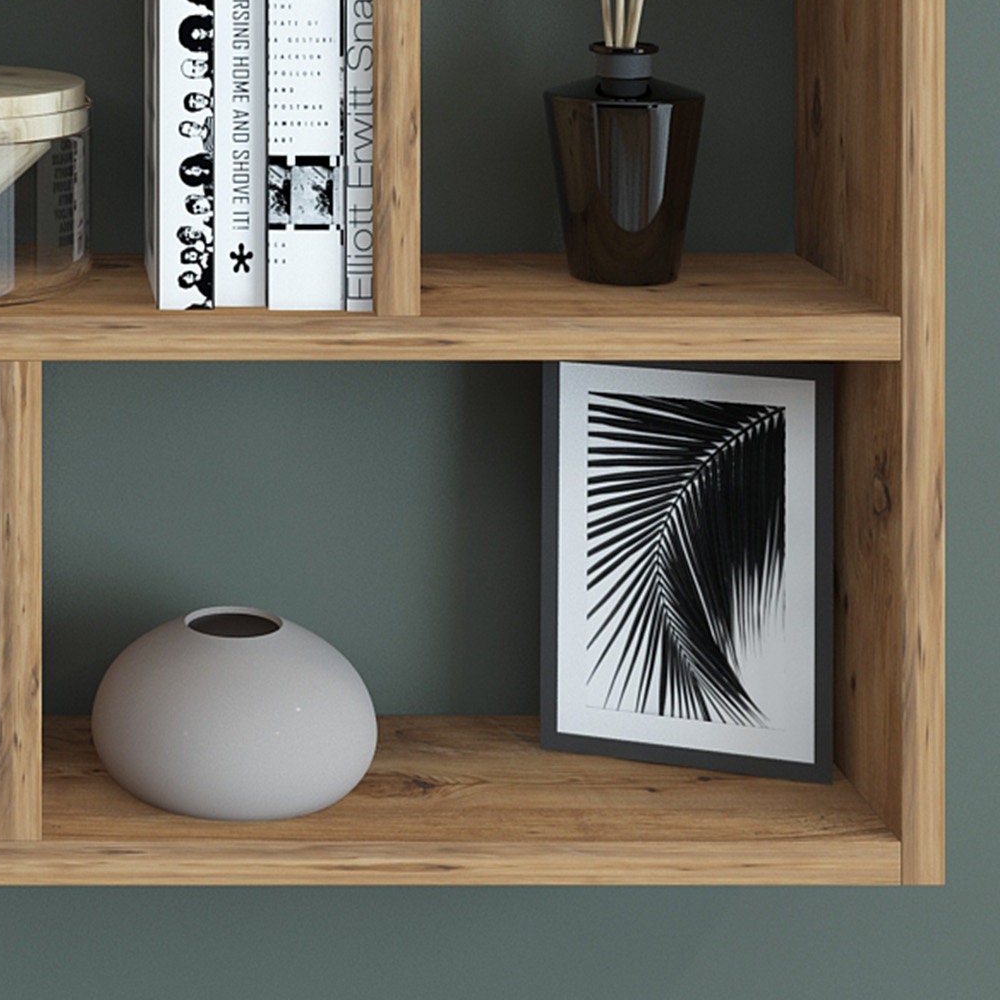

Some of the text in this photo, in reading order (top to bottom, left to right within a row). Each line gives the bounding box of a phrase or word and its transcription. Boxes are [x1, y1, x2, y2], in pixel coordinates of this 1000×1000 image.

[232, 56, 250, 103] HOME
[232, 109, 250, 143] AND
[348, 86, 373, 187] Erwitt
[232, 150, 250, 204] SHOVE
[232, 211, 250, 230] IT!
[348, 204, 373, 299] Elliott
